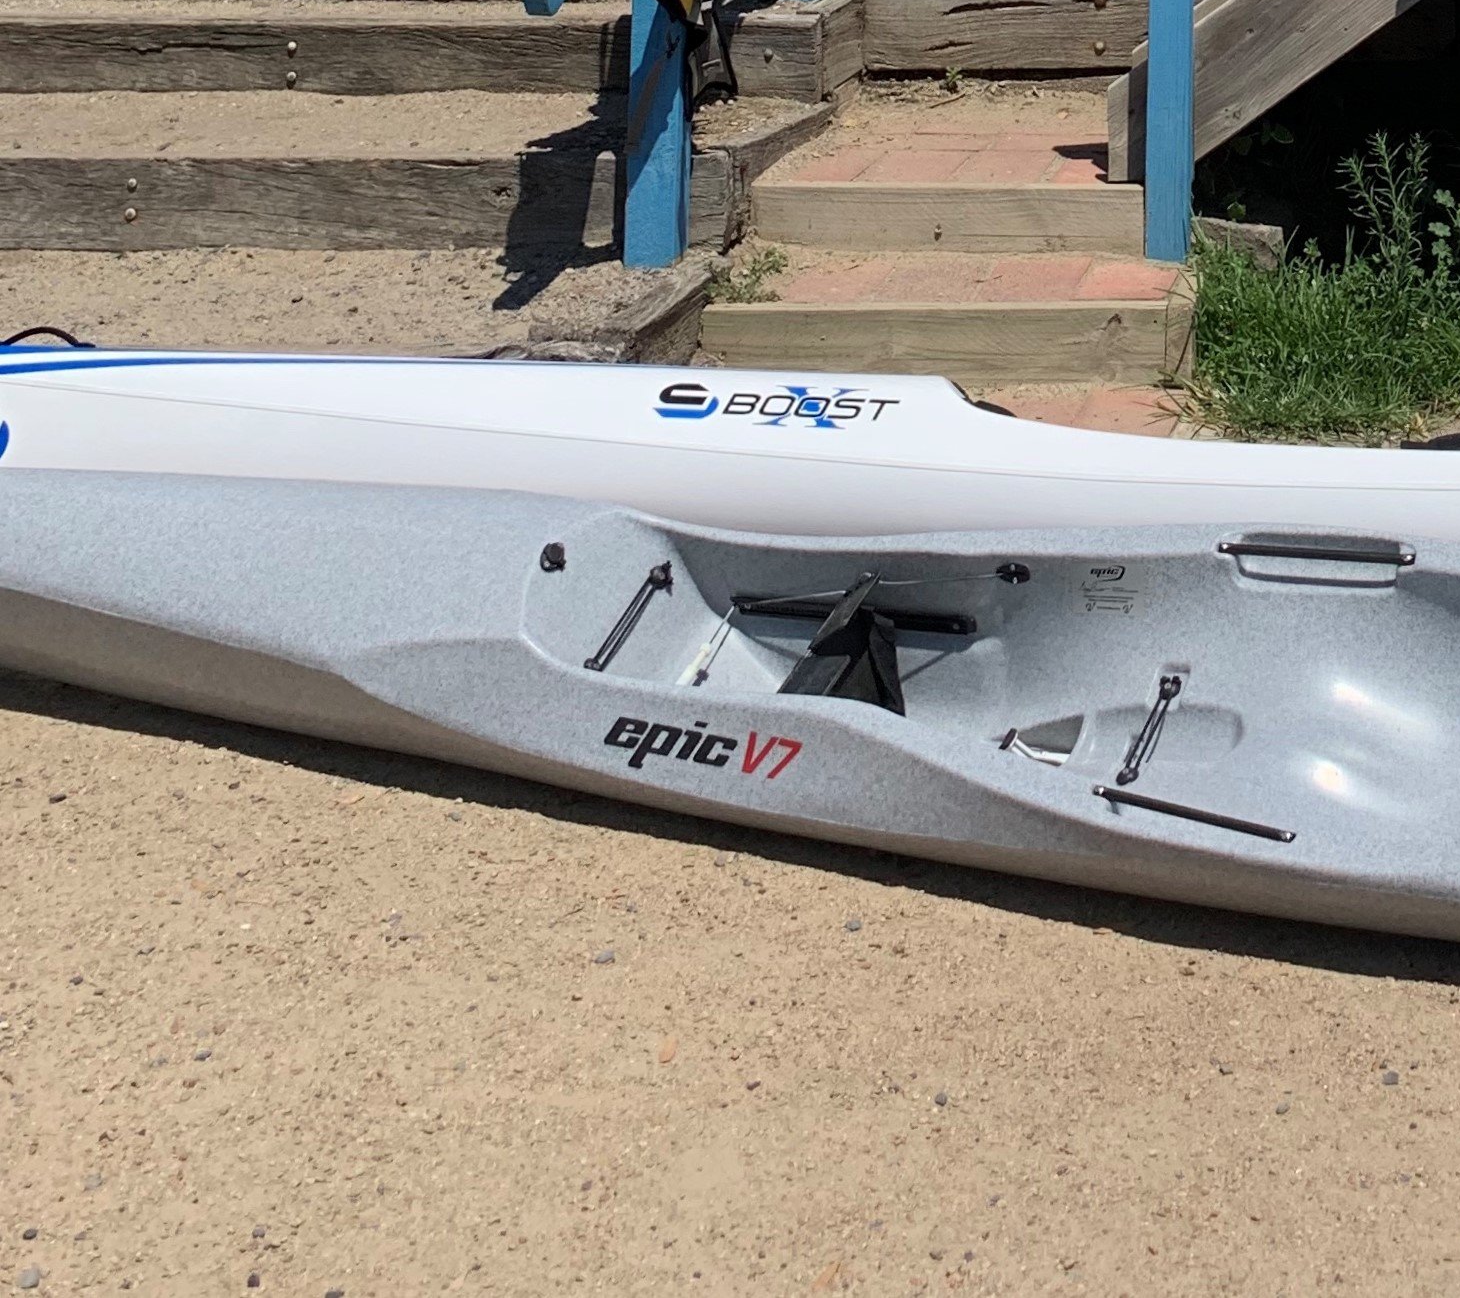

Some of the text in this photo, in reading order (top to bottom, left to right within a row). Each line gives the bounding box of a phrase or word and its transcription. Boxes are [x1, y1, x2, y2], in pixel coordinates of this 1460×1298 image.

[722, 393, 900, 422] BOOST
[604, 716, 803, 779] epic V7
